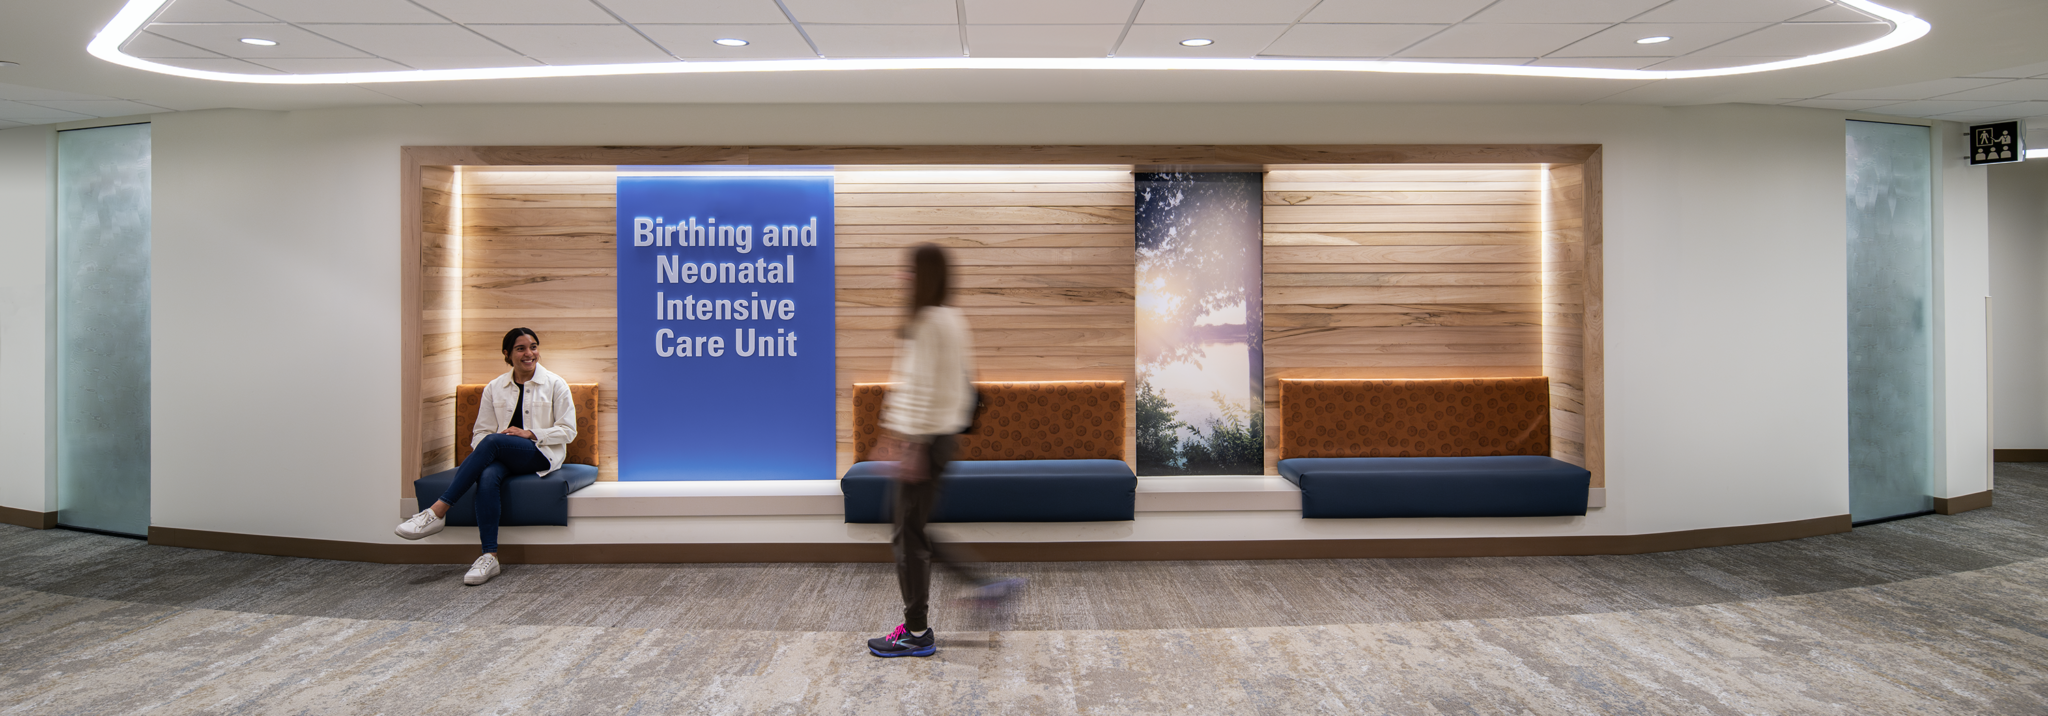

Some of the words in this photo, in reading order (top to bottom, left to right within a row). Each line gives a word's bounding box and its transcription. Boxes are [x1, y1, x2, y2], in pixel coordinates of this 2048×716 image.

[634, 217, 752, 253] Birthing
[763, 217, 817, 247] and
[657, 255, 794, 284] Neonatal
[657, 291, 795, 320] Intensive
[655, 328, 725, 357] Care
[735, 328, 797, 357] Unit
